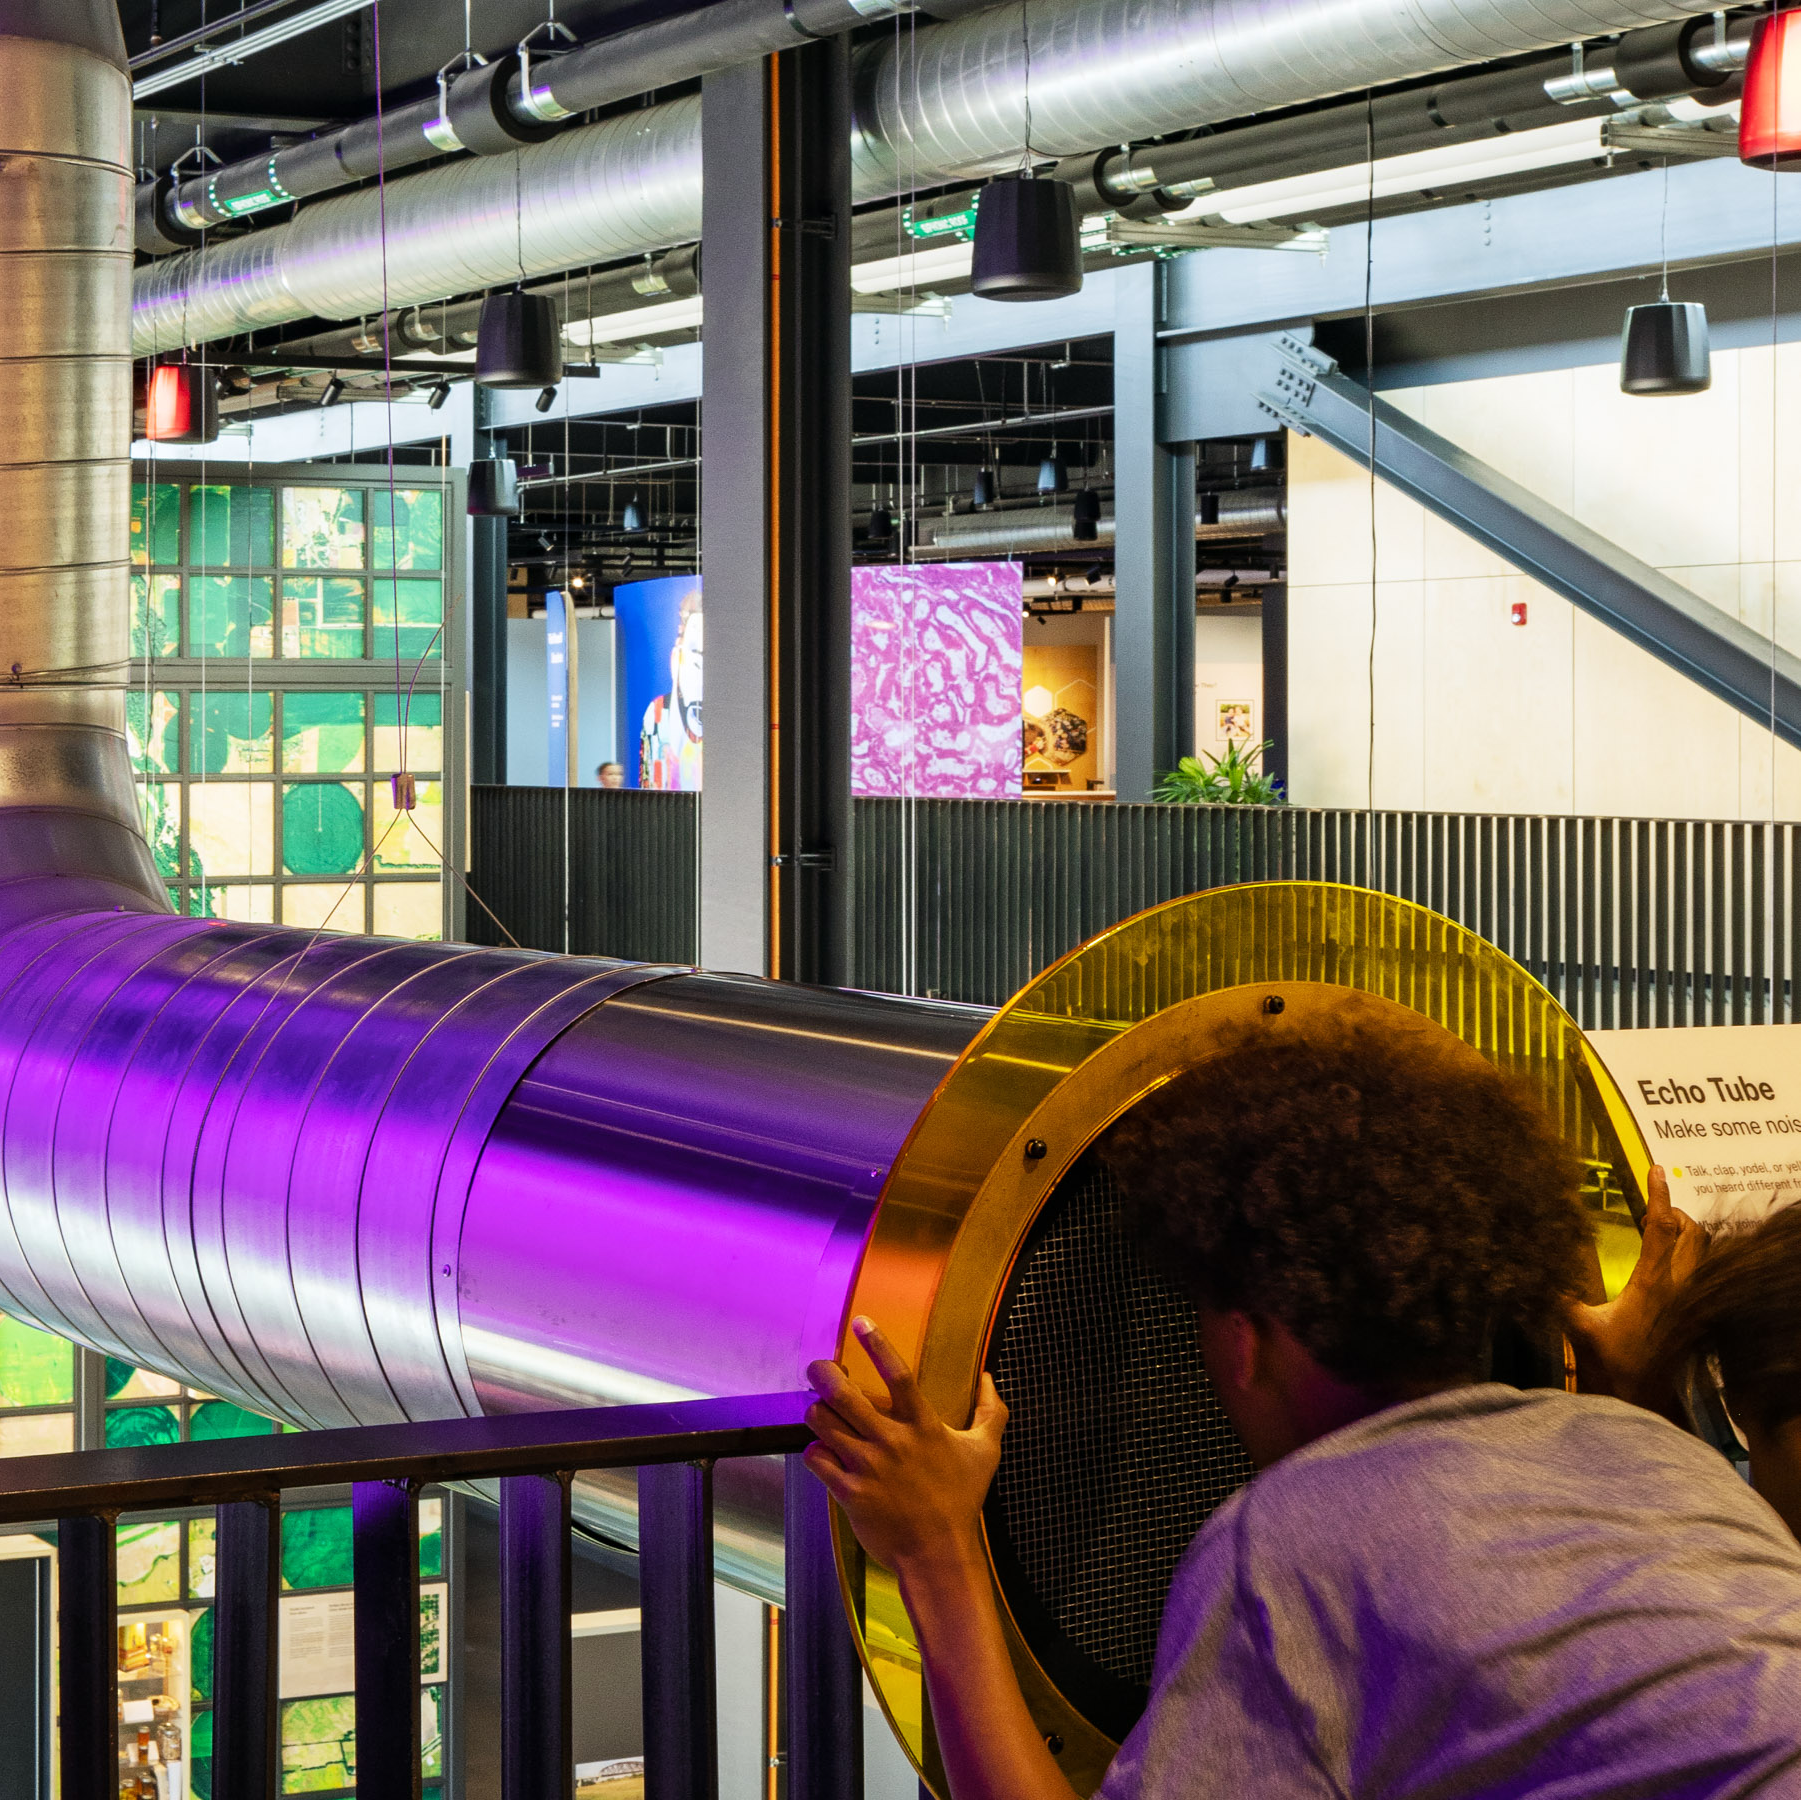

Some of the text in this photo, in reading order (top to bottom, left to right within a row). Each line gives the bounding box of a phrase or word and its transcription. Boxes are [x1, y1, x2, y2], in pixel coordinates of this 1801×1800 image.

[1637, 1076, 1776, 1106] Echo Tube
[1653, 1114, 1801, 1139] Make some nois
[1685, 1165, 1712, 1177] Talk,
[1713, 1164, 1739, 1177] clap,
[1739, 1162, 1772, 1177] yodel,
[1773, 1164, 1783, 1173] or
[1693, 1185, 1713, 1196] you
[1713, 1180, 1745, 1193] heard
[1746, 1179, 1792, 1192] different
